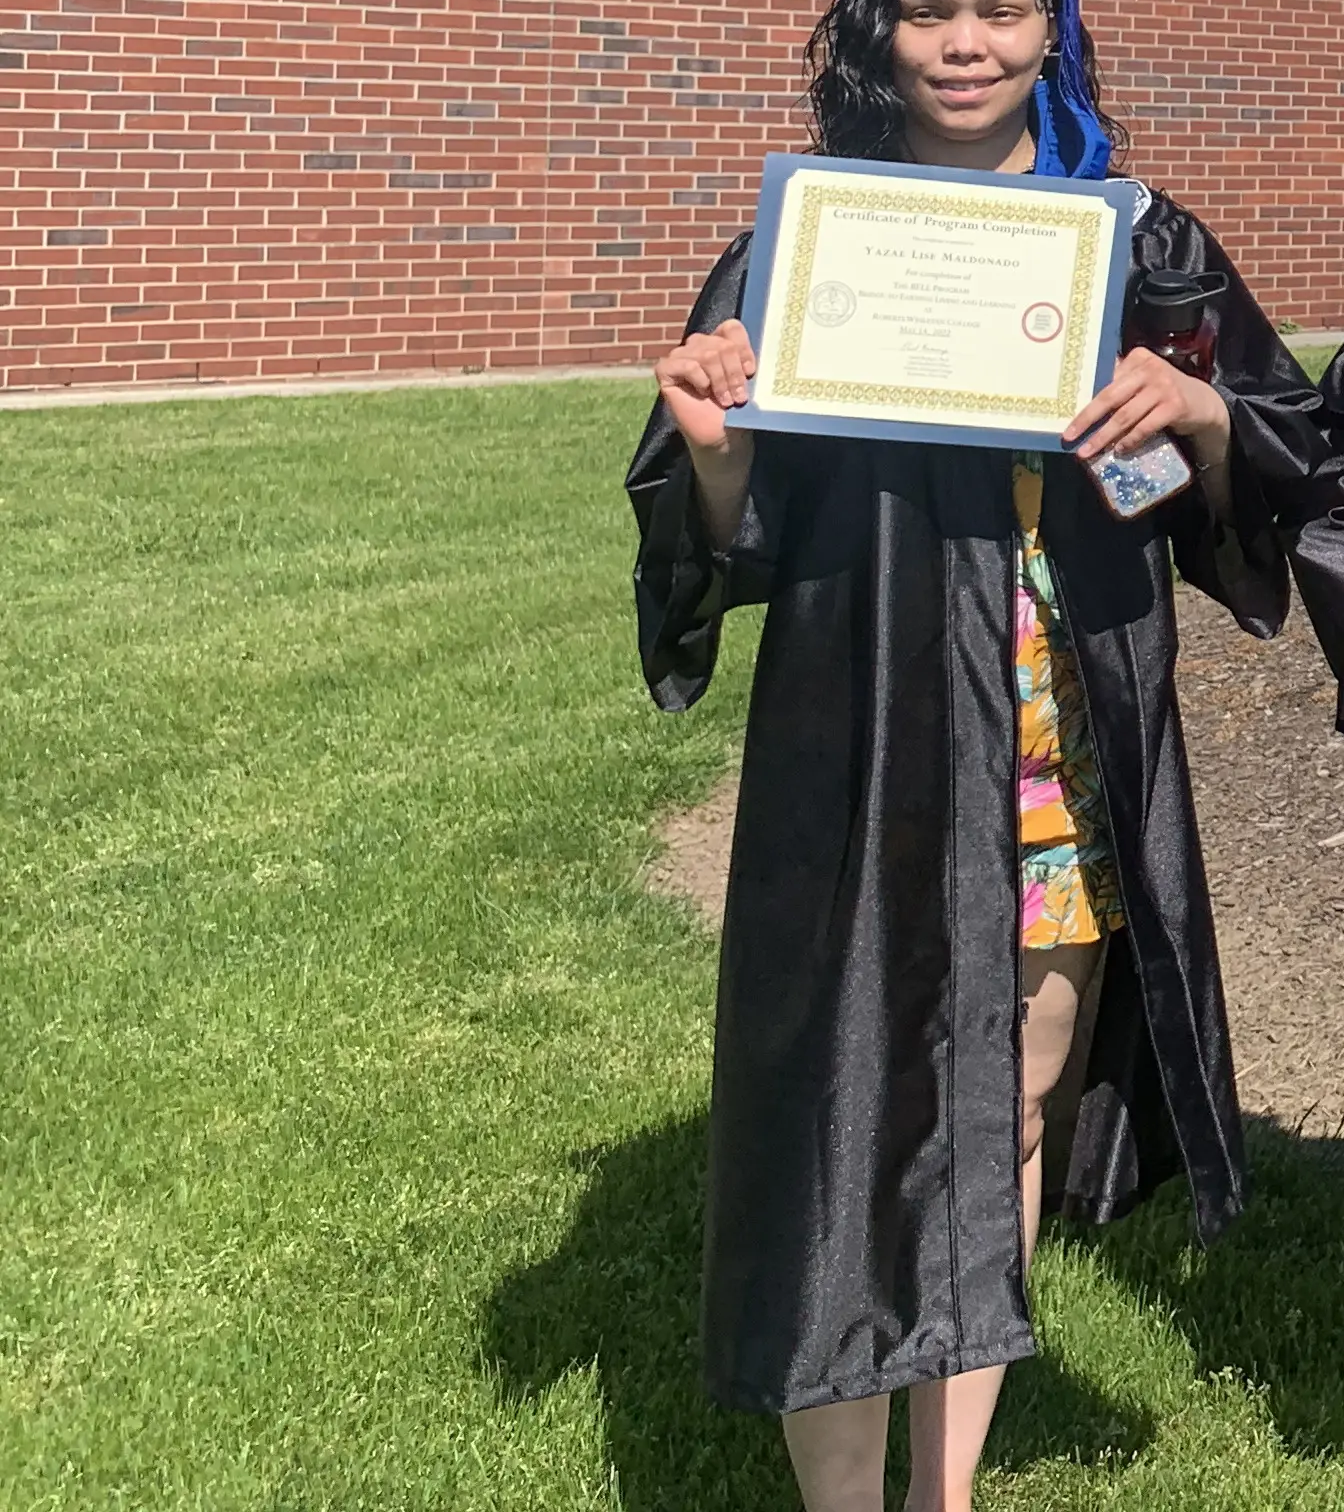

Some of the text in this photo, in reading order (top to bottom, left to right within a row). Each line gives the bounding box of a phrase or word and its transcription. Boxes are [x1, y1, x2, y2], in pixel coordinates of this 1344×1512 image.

[833, 208, 1057, 238] Certificate of Program Completion
[941, 252, 1020, 267] MALDONADO
